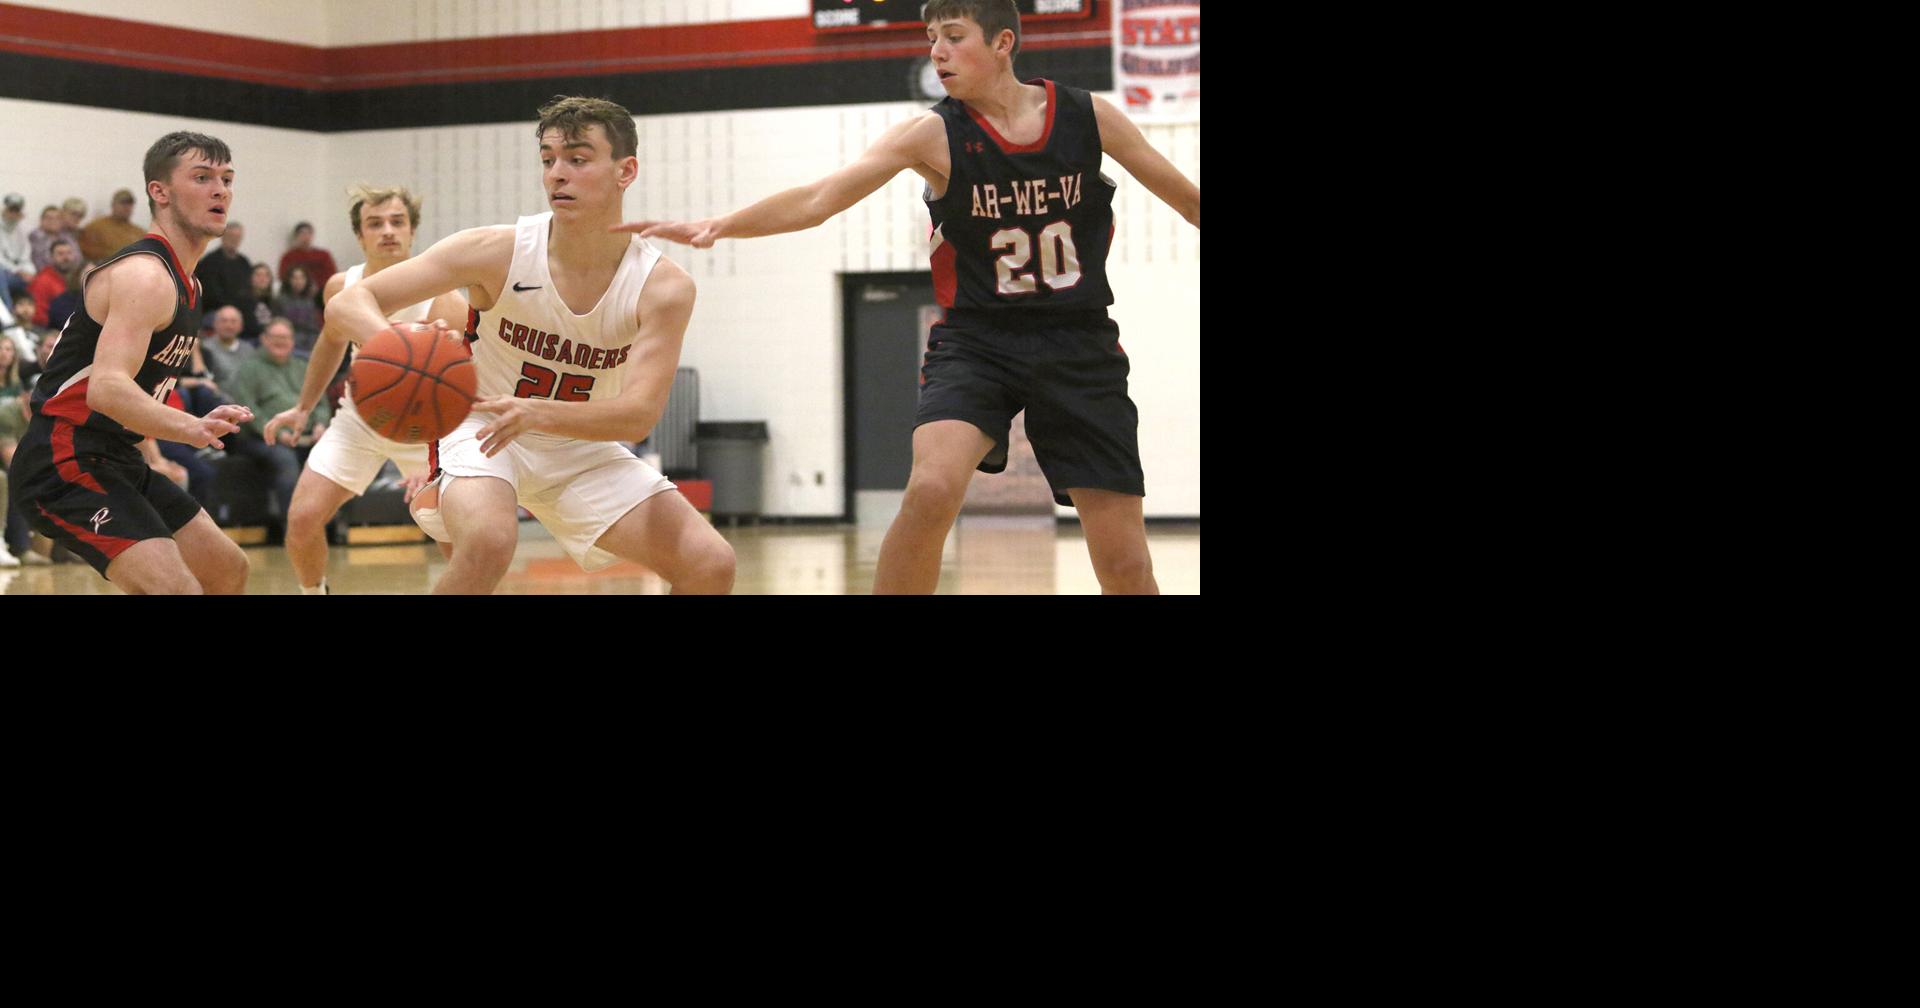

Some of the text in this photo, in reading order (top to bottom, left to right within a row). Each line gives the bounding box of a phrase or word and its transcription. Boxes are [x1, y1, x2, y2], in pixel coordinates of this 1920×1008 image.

[814, 8, 860, 28] SCORE
[971, 172, 1082, 219] AR-WE-VA
[990, 219, 1083, 296] 20
[498, 317, 632, 370] CRUSADERS
[513, 361, 596, 402] 25
